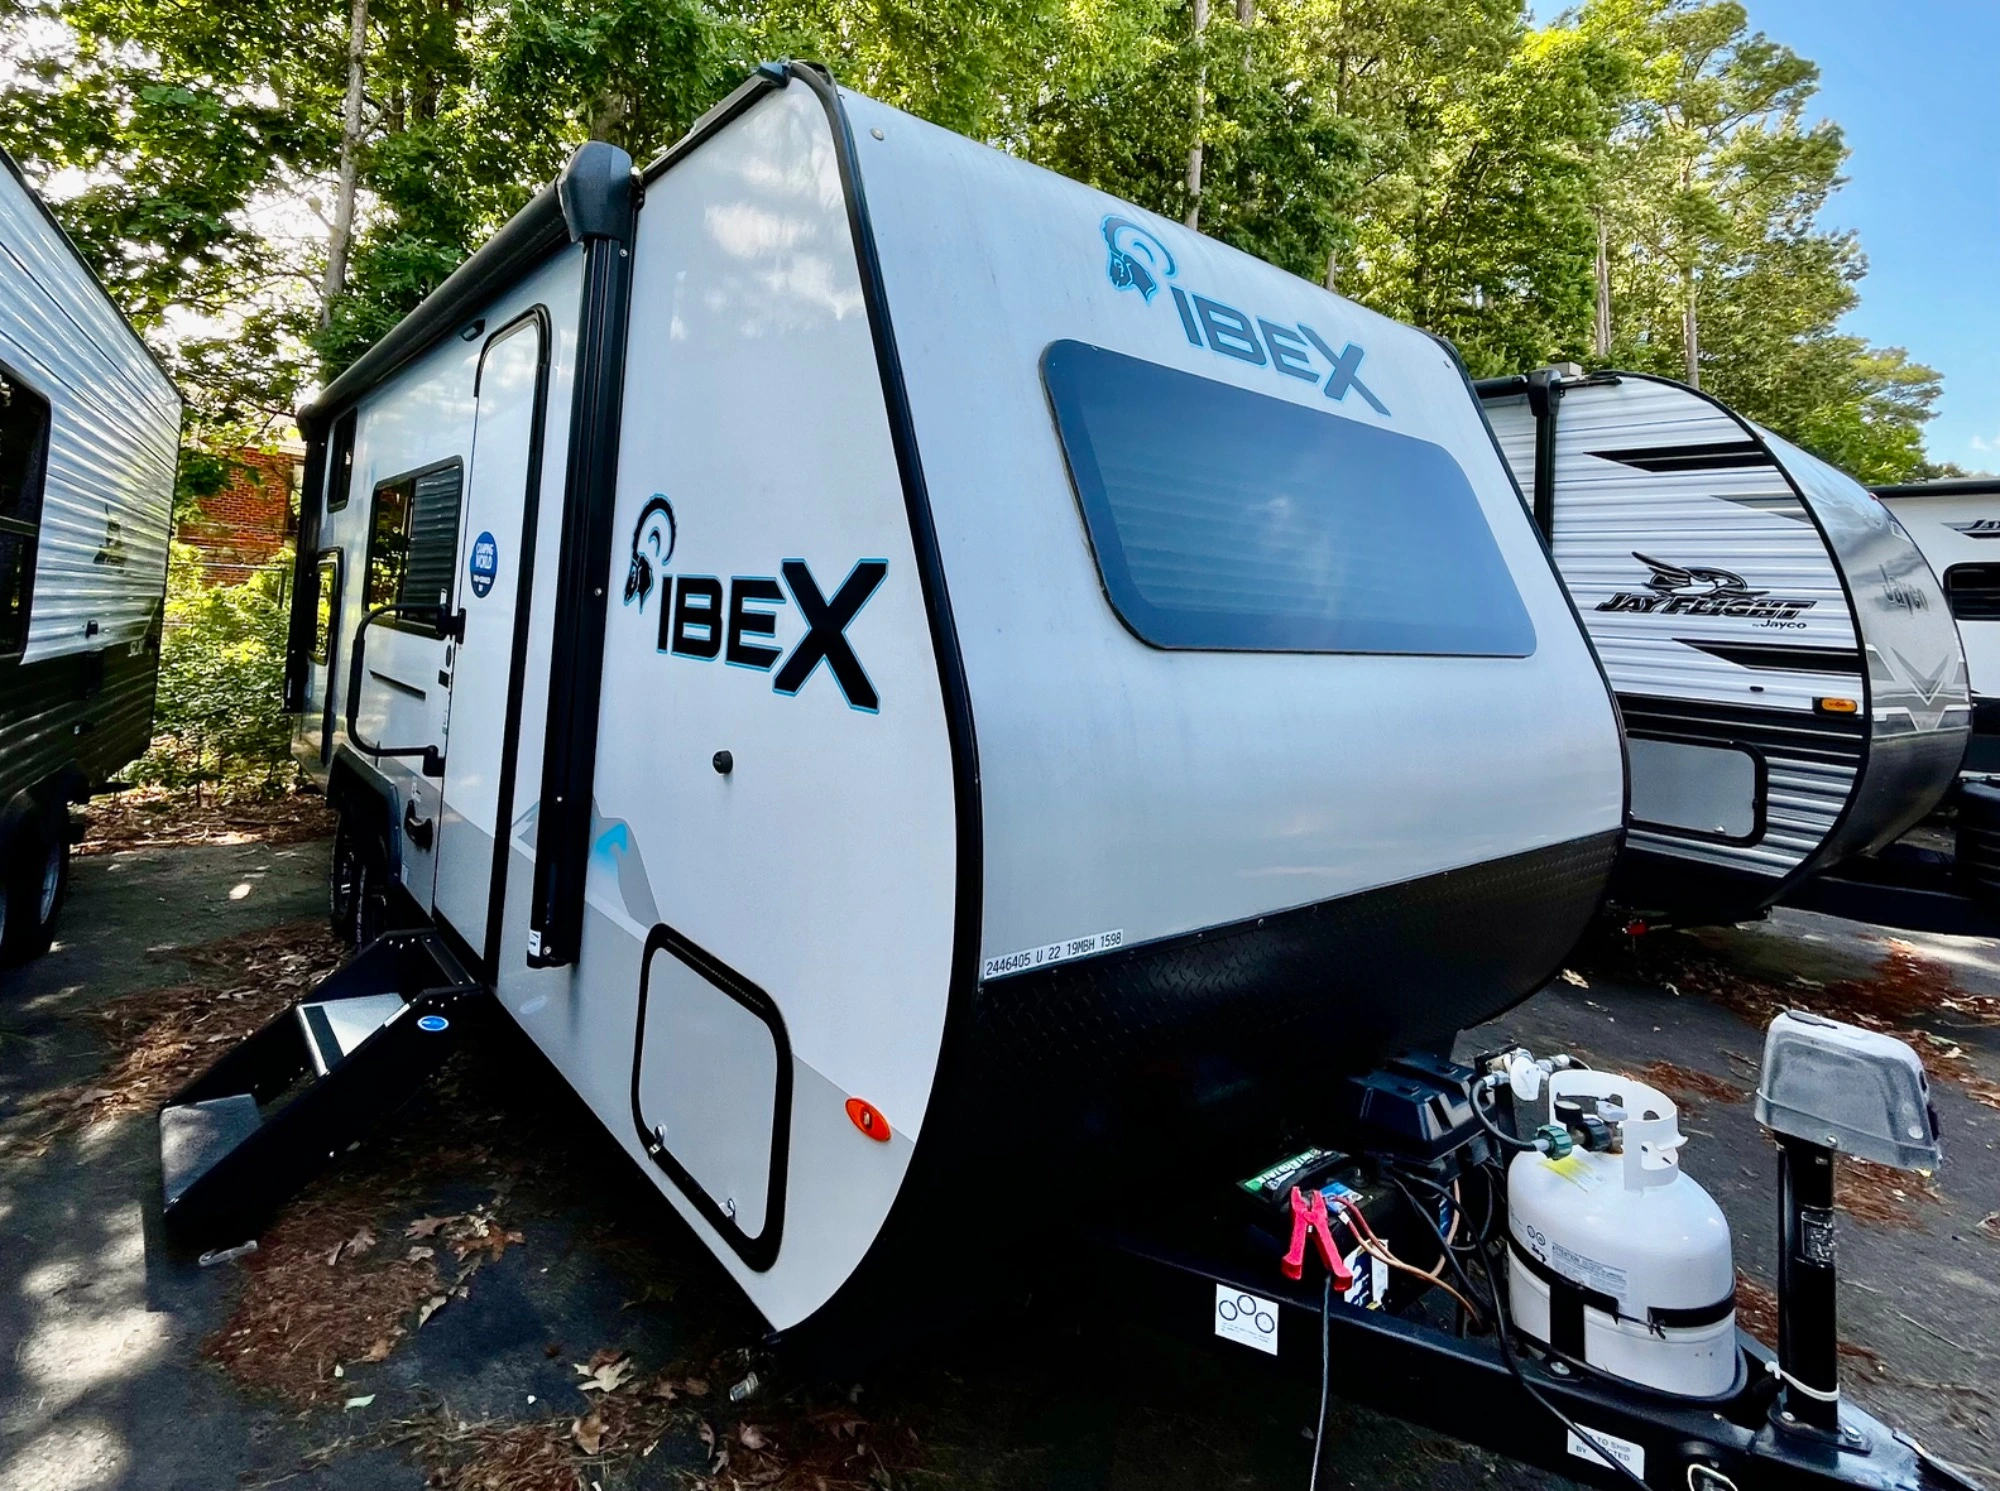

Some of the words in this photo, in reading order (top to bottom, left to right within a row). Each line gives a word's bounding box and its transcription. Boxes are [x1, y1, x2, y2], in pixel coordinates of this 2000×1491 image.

[1169, 284, 1392, 417] IBEX
[656, 558, 889, 715] IBEX
[1760, 619, 1807, 630] Jayco
[986, 952, 1031, 976] 2446405
[1036, 949, 1043, 963] U
[1048, 945, 1061, 960] 22
[1067, 938, 1095, 955] 19MBH
[1100, 931, 1122, 948] 1598
